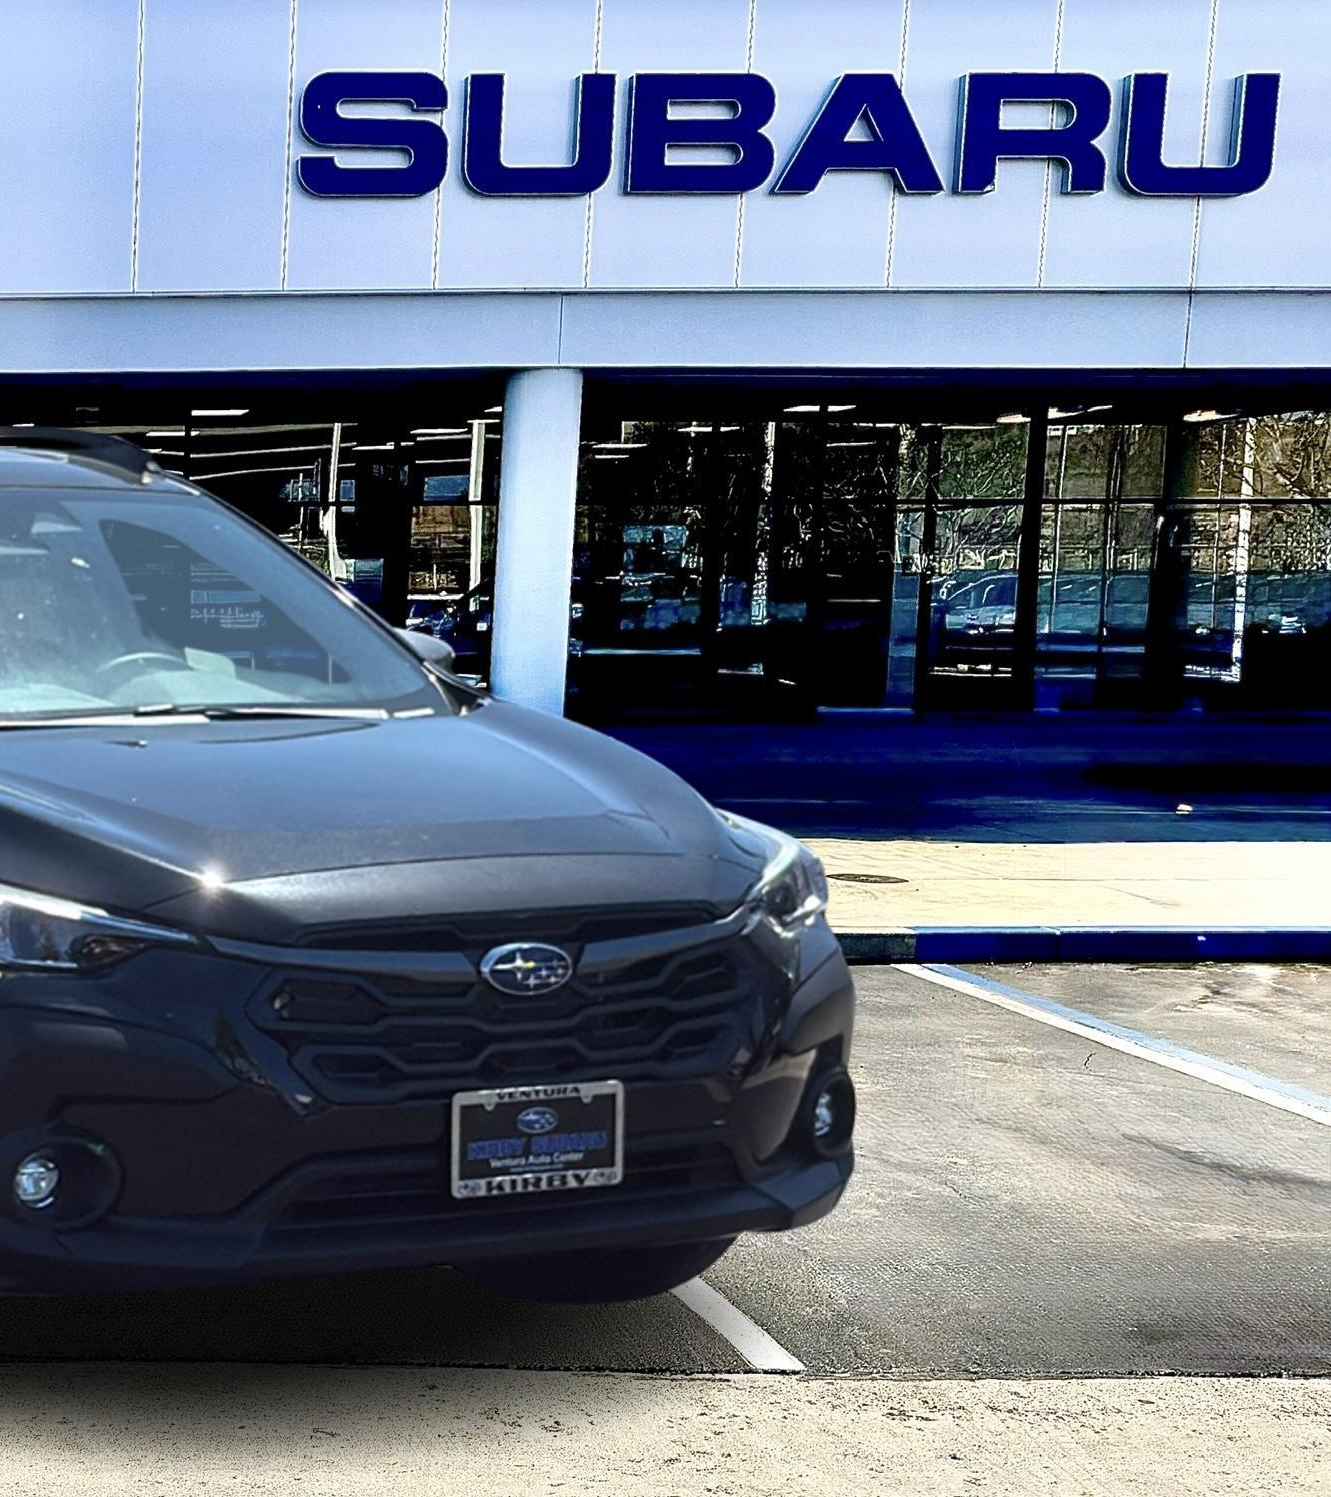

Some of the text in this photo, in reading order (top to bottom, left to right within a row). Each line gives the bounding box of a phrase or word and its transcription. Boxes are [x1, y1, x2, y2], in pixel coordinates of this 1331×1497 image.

[298, 72, 1280, 199] SUBARU
[497, 1086, 581, 1101] VENTURA
[489, 1156, 526, 1168] Ventura
[528, 1153, 551, 1164] Auto
[553, 1151, 584, 1163] Center
[486, 1172, 591, 1194] KIRBY
